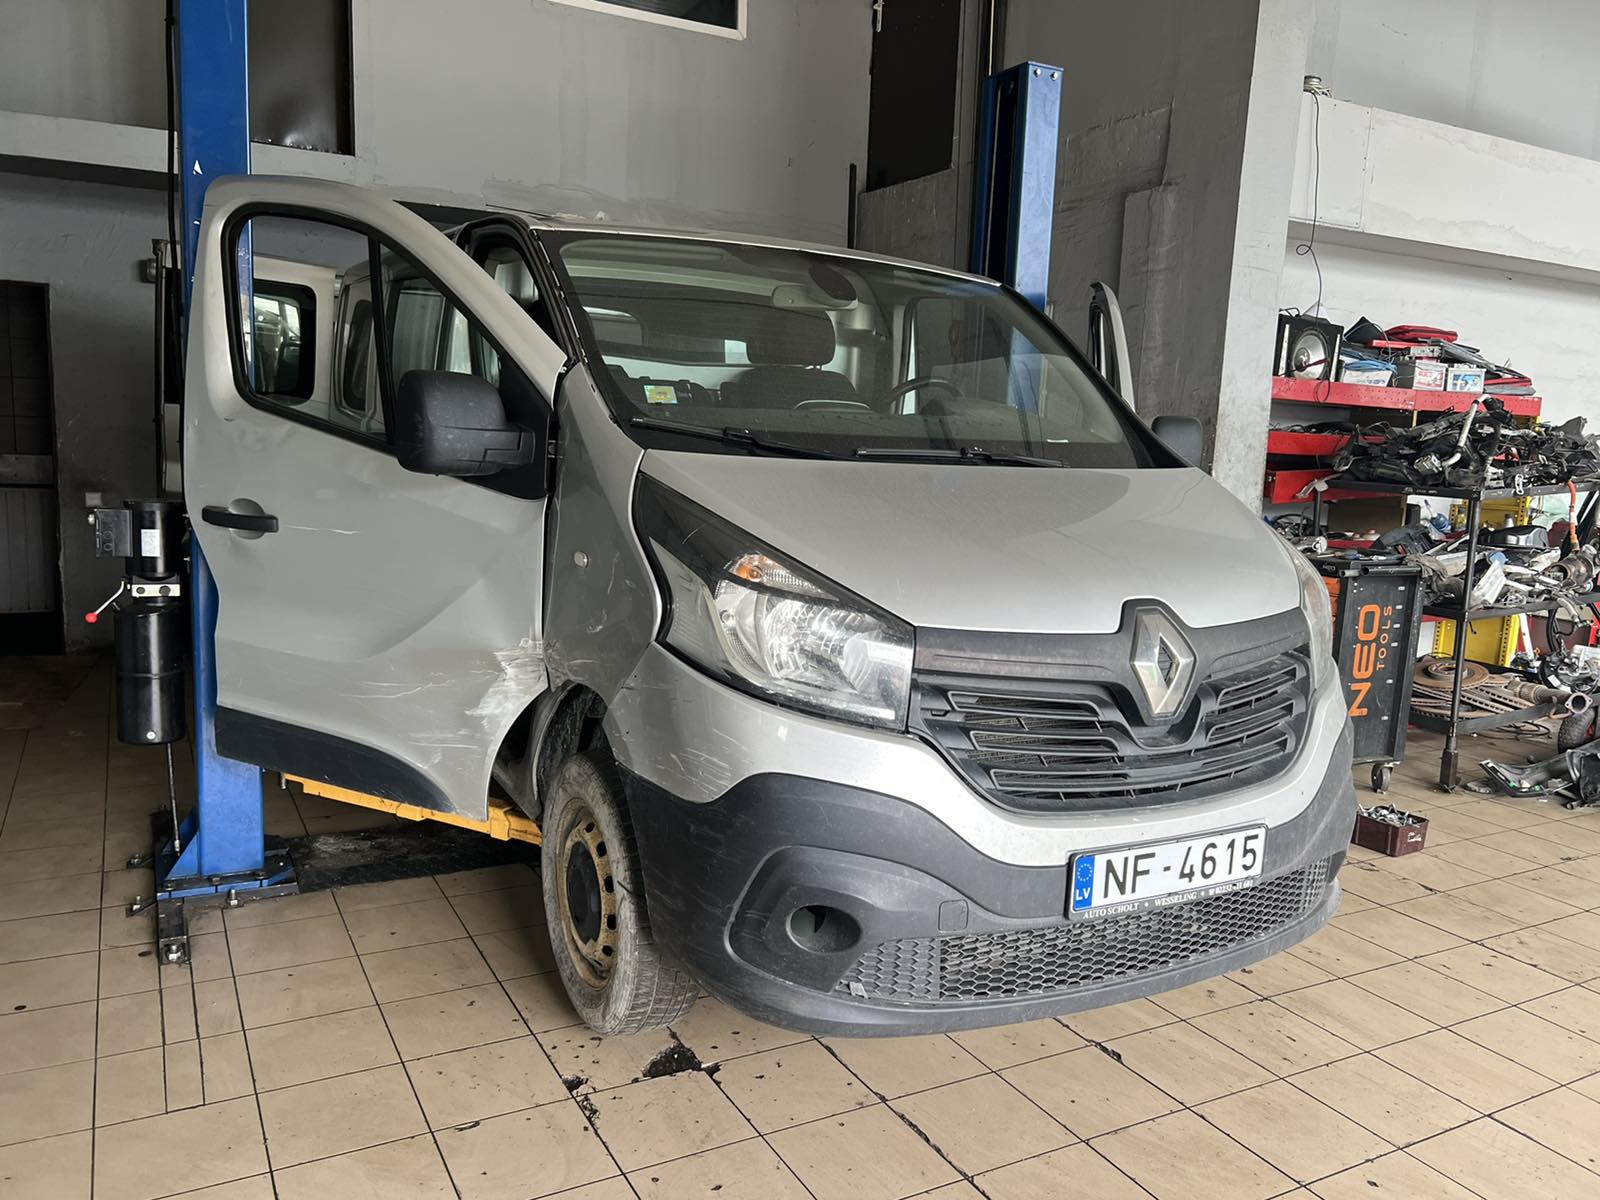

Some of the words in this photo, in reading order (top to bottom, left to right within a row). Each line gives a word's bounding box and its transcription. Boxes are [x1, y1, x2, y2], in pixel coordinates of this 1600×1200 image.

[1376, 605, 1393, 671] TOOLS
[1347, 604, 1381, 717] NEO
[1075, 888, 1091, 902] LV
[1082, 909, 1106, 919] AUTO
[1107, 902, 1140, 915] SCHOLT
